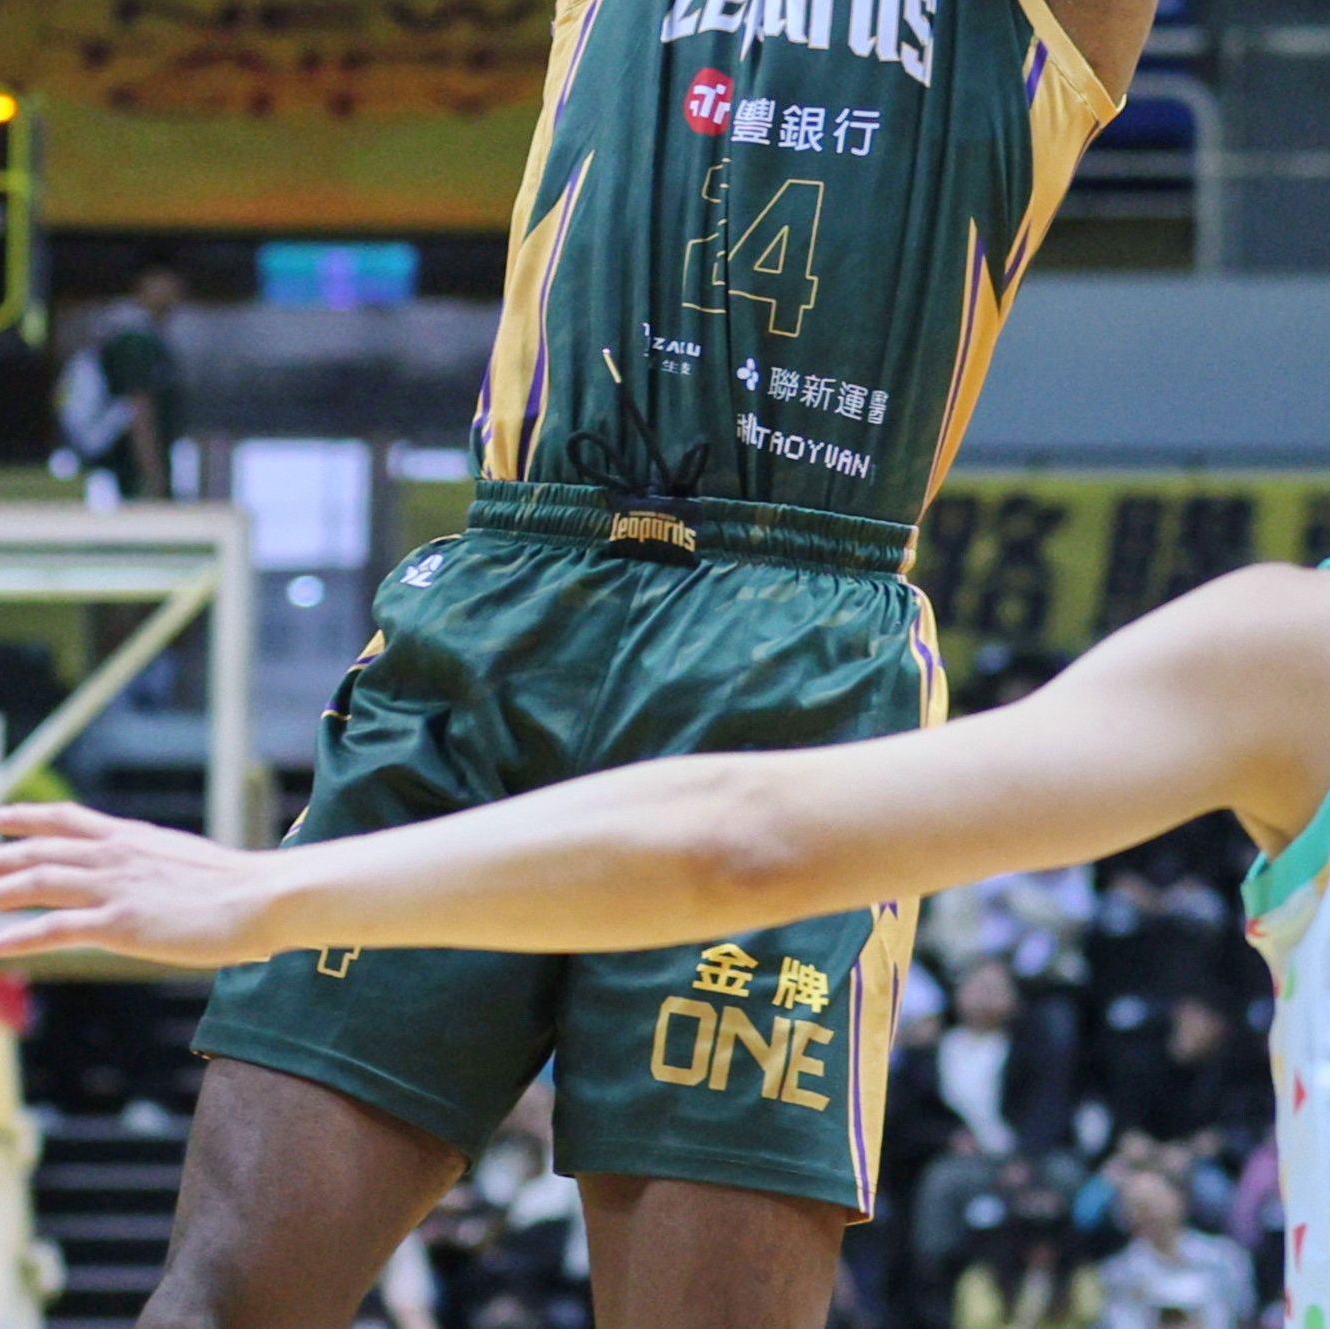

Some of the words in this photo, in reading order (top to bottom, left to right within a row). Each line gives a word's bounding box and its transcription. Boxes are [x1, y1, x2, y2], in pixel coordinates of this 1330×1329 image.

[681, 156, 825, 338] 24
[755, 424, 872, 479] TAOYUAN
[608, 512, 698, 552] Leopards
[691, 942, 831, 1014] 金牌
[649, 995, 836, 1113] ONE
